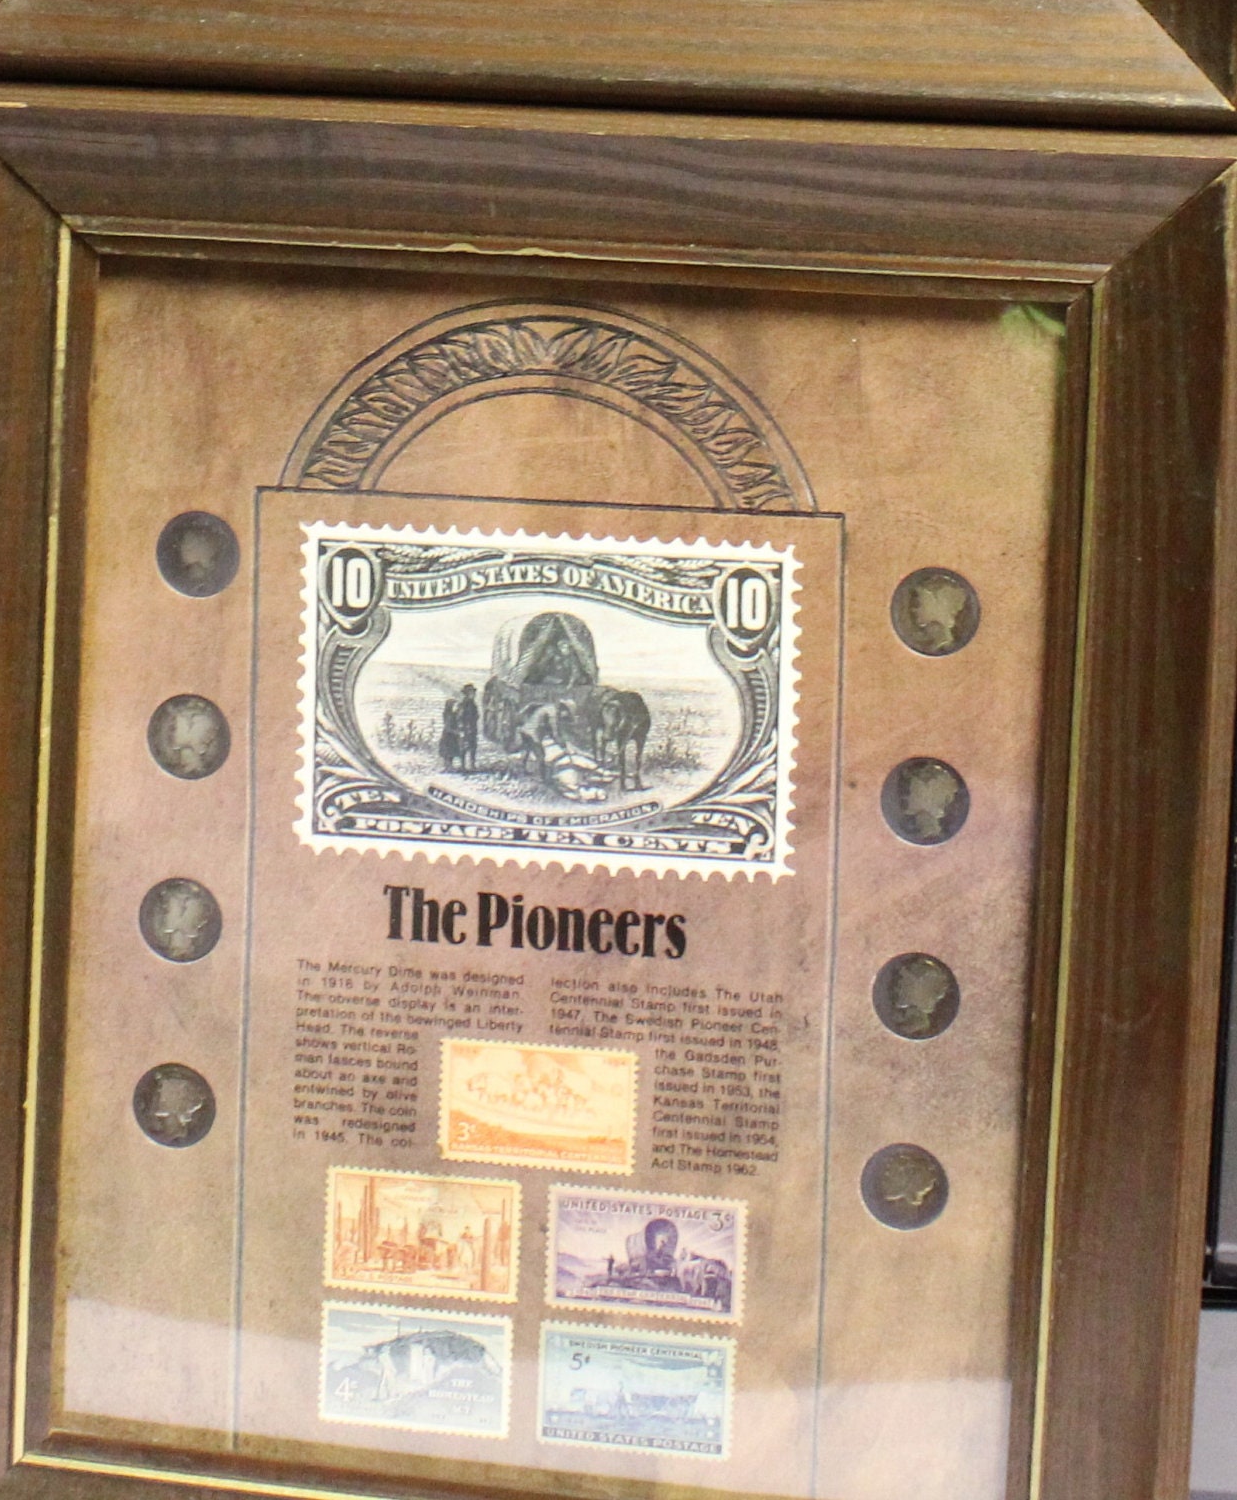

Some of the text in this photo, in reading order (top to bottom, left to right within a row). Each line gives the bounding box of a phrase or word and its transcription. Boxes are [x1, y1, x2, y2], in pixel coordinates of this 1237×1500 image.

[332, 557, 371, 608] 10
[387, 564, 713, 614] UNITED STATES OF AMERICA
[727, 578, 767, 630] 10
[335, 790, 401, 810] TEN
[432, 789, 654, 825] HARDSHIPS OF EMIGRATION
[356, 818, 731, 854] POSTAGE TEN CENTS
[692, 813, 756, 836] TEN
[384, 884, 686, 959] The Pioneers
[297, 959, 524, 985] The Mercury Dime was designed
[295, 1039, 337, 1049] shows
[342, 1041, 392, 1053] vertical
[653, 1096, 780, 1114] Kansas Territorial
[293, 1116, 415, 1132] was redesigned
[652, 1158, 674, 1169] Act
[678, 1160, 721, 1173] Stamp
[563, 1200, 708, 1220] UNITED STATES POSTAGE
[569, 1340, 703, 1360] SWEDISH PIONEER CENTENNIAL
[546, 1428, 718, 1453] UNITED STATES POSTAGE
